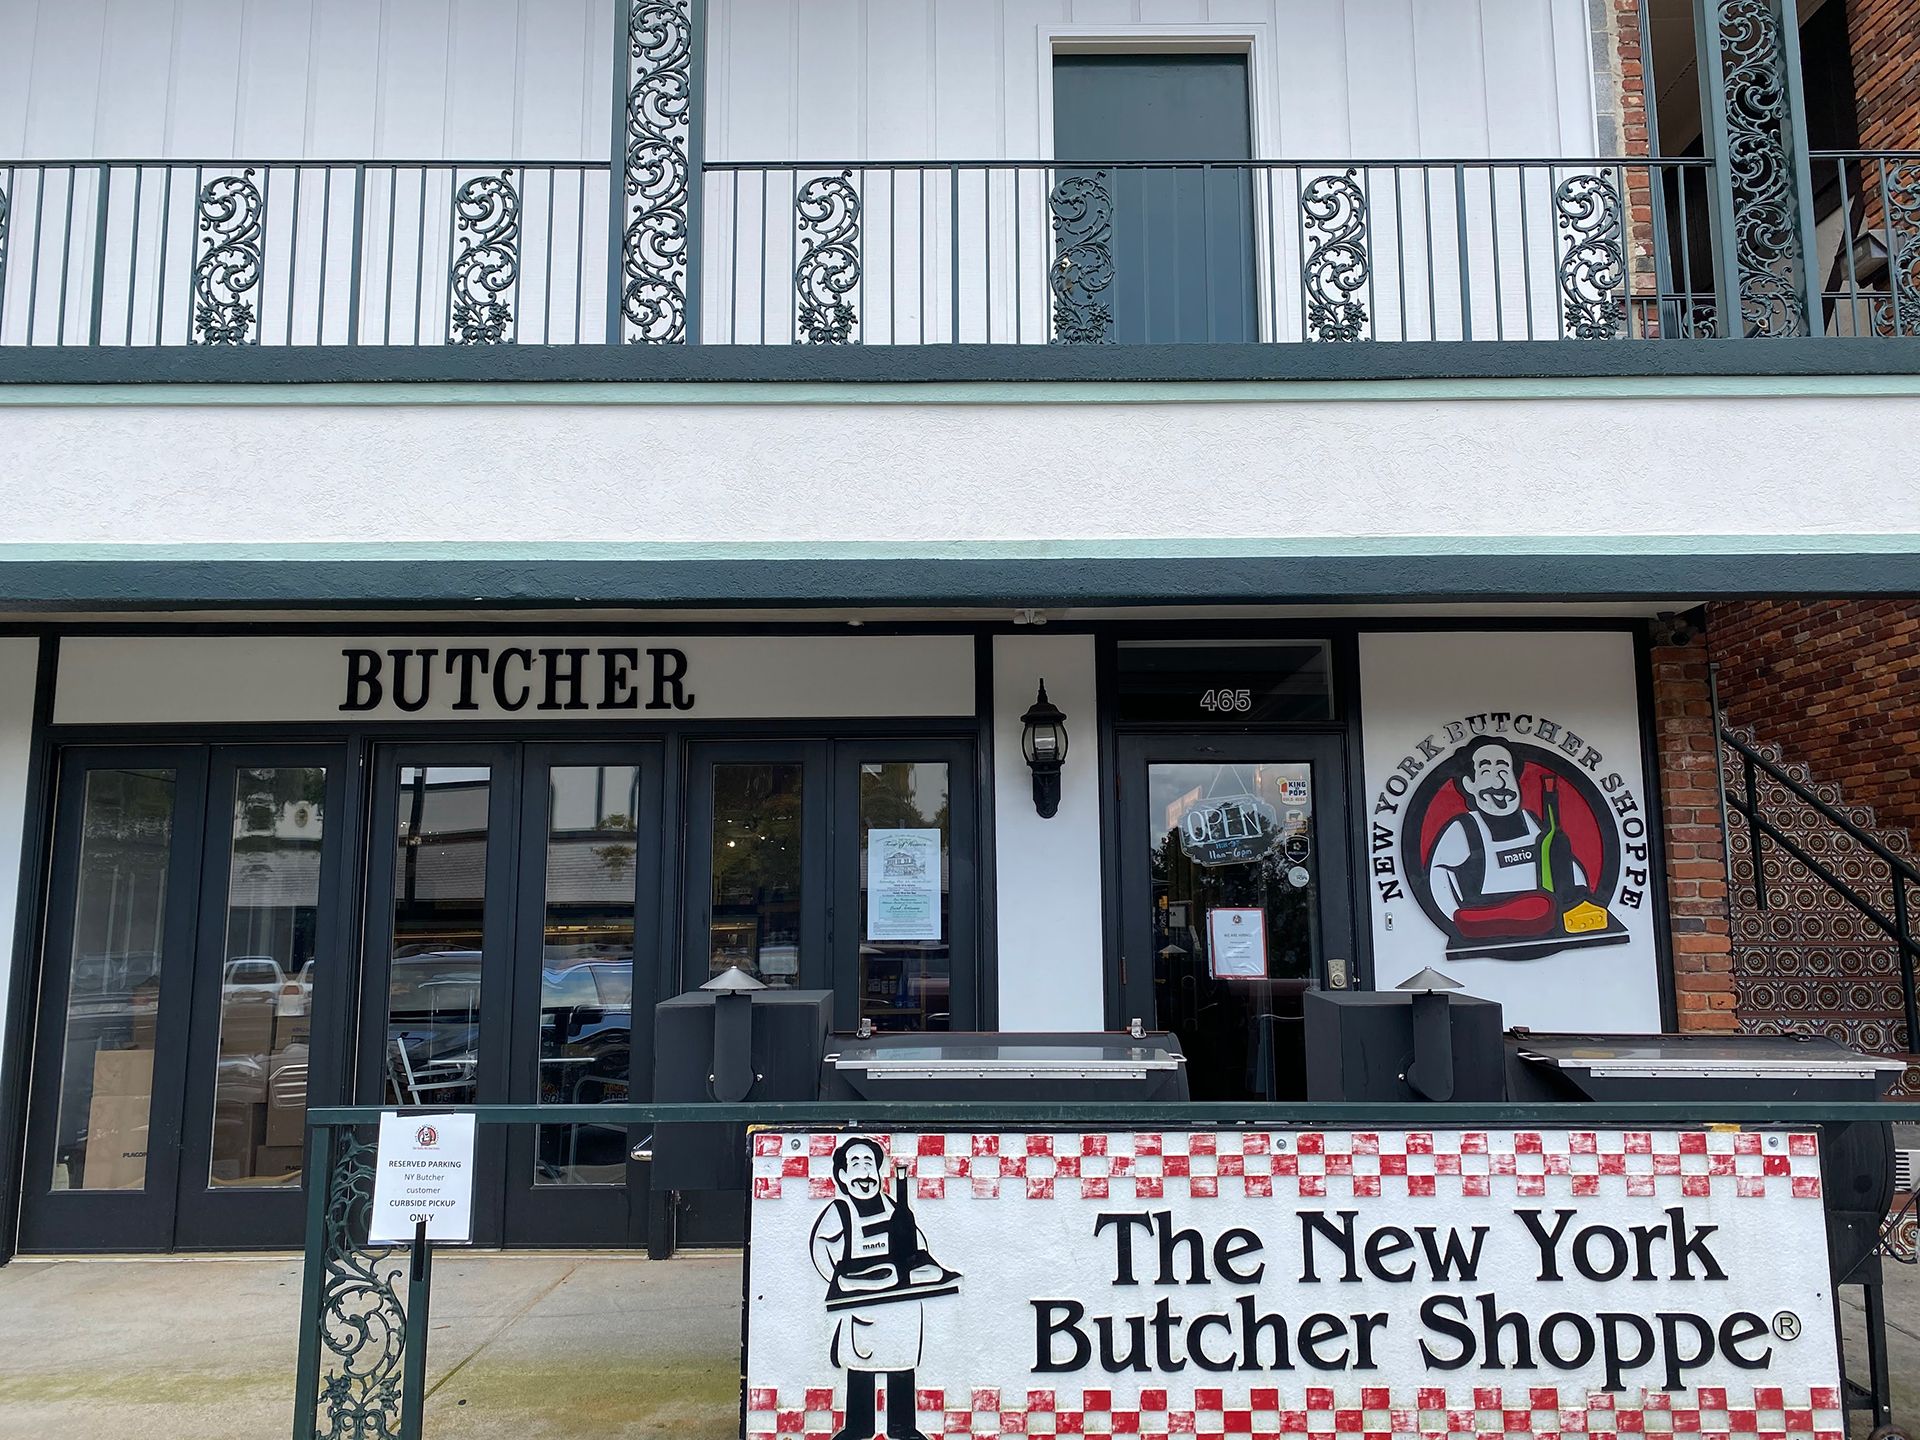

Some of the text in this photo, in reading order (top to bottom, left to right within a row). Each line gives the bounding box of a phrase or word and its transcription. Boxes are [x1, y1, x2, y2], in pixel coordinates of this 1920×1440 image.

[338, 647, 695, 712] BUTCHER
[1200, 688, 1252, 712] 465
[1372, 712, 1648, 910] NEW YORK BUTCHER SHOPPE
[1187, 803, 1263, 842] OPEN
[1503, 849, 1533, 864] mario
[388, 1160, 462, 1169] RESERVED PARKING
[404, 1173, 445, 1181] NY Butcher
[389, 1199, 456, 1207] CURBSIDE PICKUP
[409, 1213, 435, 1222] ONLY
[862, 1241, 886, 1250] mario
[1094, 1206, 1729, 1286] The New York
[1029, 1295, 1389, 1374] Butcher
